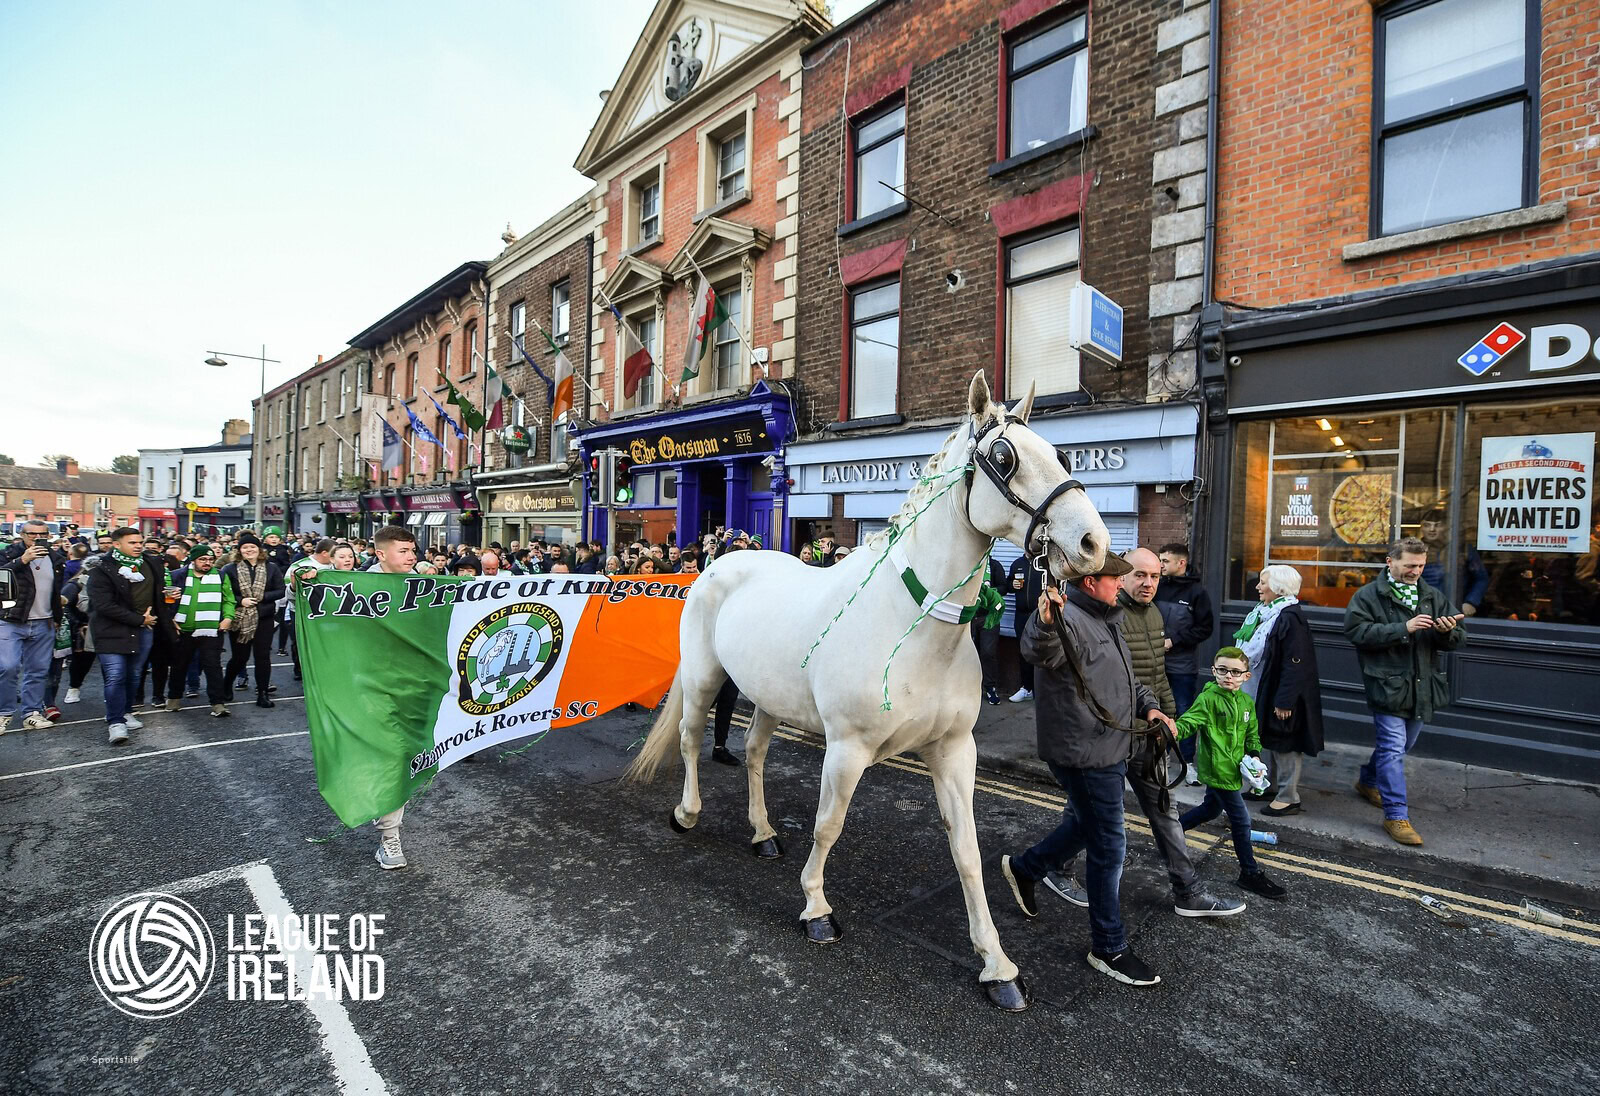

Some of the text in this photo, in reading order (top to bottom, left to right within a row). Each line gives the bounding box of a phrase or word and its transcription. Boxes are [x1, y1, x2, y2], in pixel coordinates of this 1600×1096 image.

[1104, 319, 1110, 331] &
[1529, 323, 1600, 372] D
[505, 439, 529, 447] Heineken
[630, 438, 657, 464] The
[734, 432, 752, 444] 1816
[821, 460, 921, 483] LAUNDRY &
[1289, 494, 1312, 505] NEW
[1486, 477, 1587, 500] DRIVERS
[504, 494, 520, 512] The
[1287, 505, 1313, 515] YORK
[1280, 515, 1319, 526] HOTDOG
[1487, 507, 1581, 529] WANTED
[1497, 535, 1568, 544] APPLY WITHIN
[301, 582, 391, 619] The
[399, 578, 511, 612] Pride
[459, 604, 562, 660] PRIDE OF RINGSEND SC
[484, 704, 500, 714] NA
[504, 678, 539, 706] RINNE
[410, 701, 597, 779] Shamrock Rovers SC
